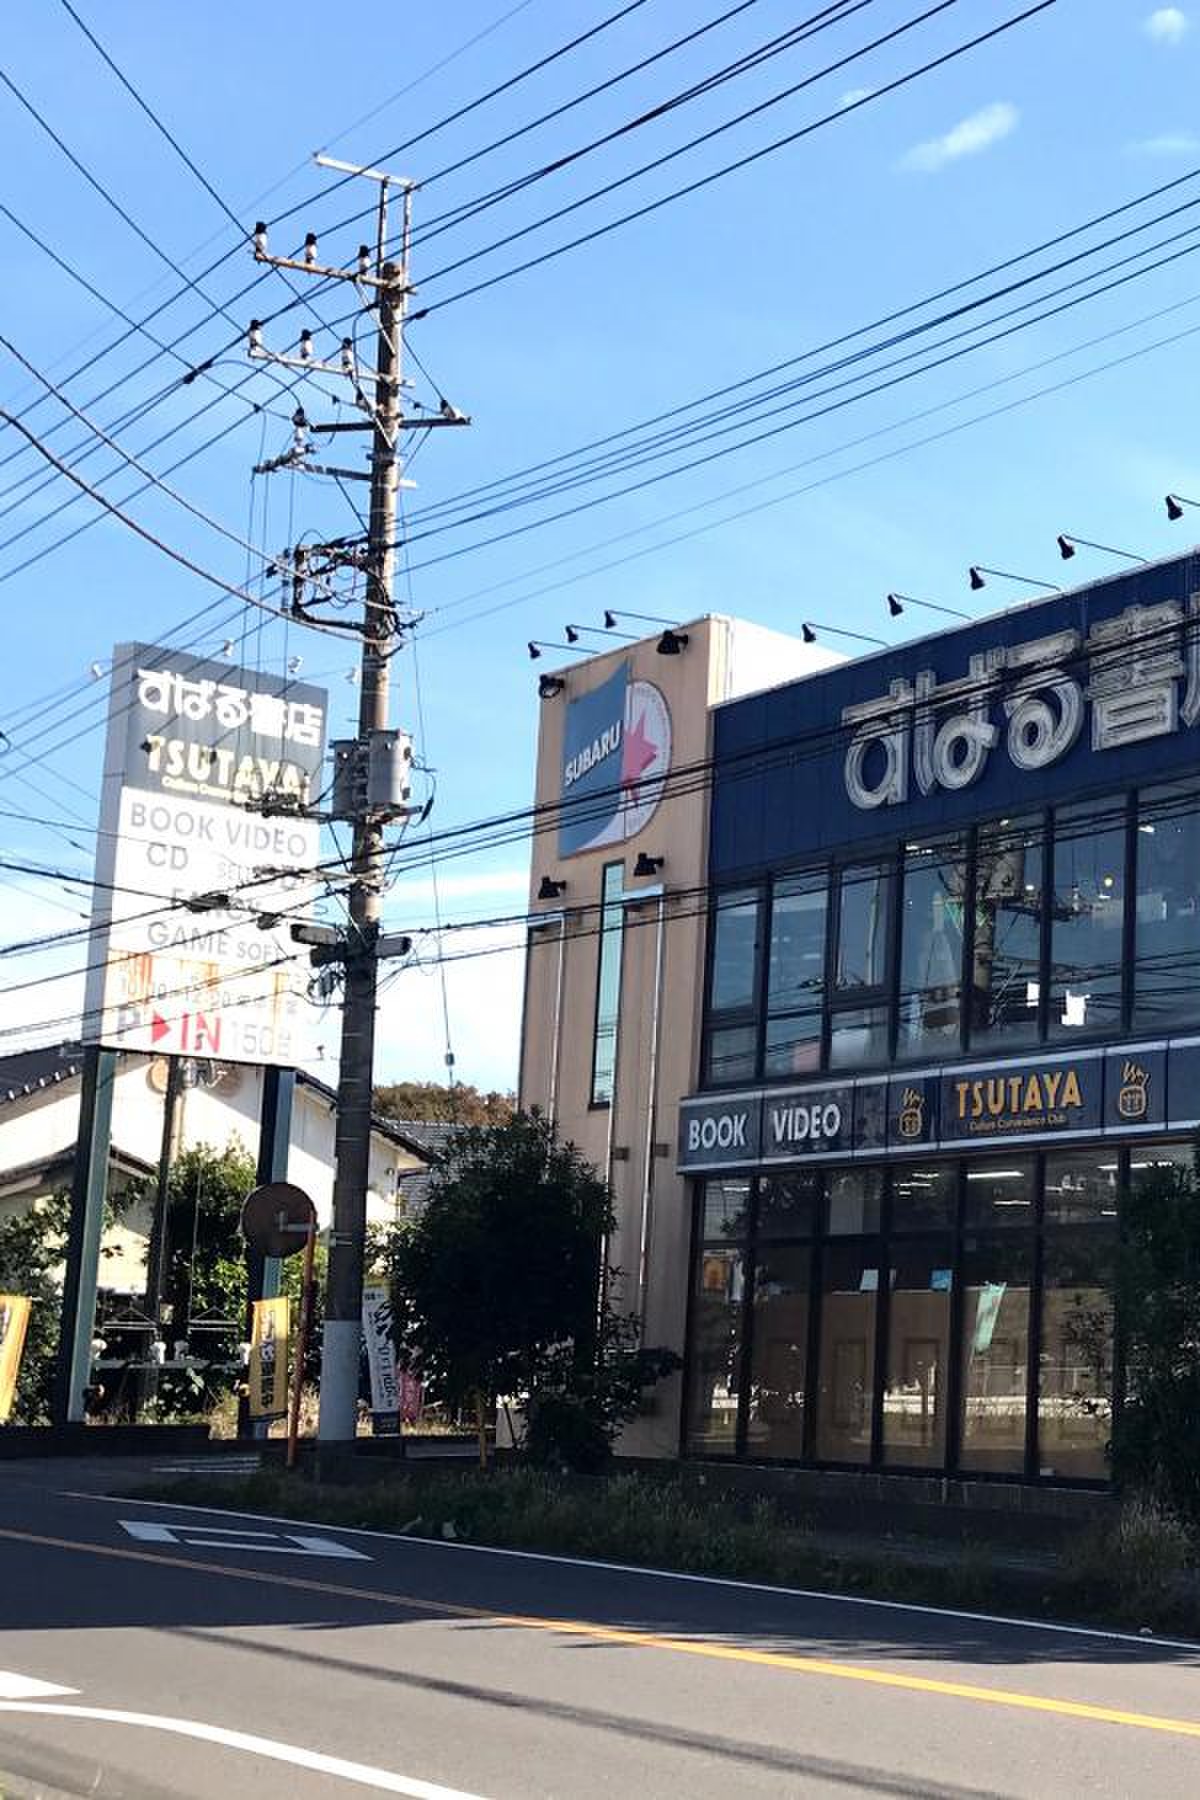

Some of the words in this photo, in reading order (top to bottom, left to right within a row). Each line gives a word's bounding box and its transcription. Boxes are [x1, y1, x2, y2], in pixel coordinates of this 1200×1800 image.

[137, 667, 323, 748] すばる書店
[147, 735, 301, 795] TSUTAYA
[564, 720, 624, 786] SUBARU
[130, 802, 214, 842] BOOK
[226, 819, 306, 858] VIDEO
[147, 842, 189, 871] CD
[147, 921, 231, 955] GAME
[179, 1009, 222, 1054] IN
[955, 1071, 1083, 1119] TSUTAYA
[688, 1113, 747, 1150] BOOK
[772, 1104, 841, 1143] VIDEO
